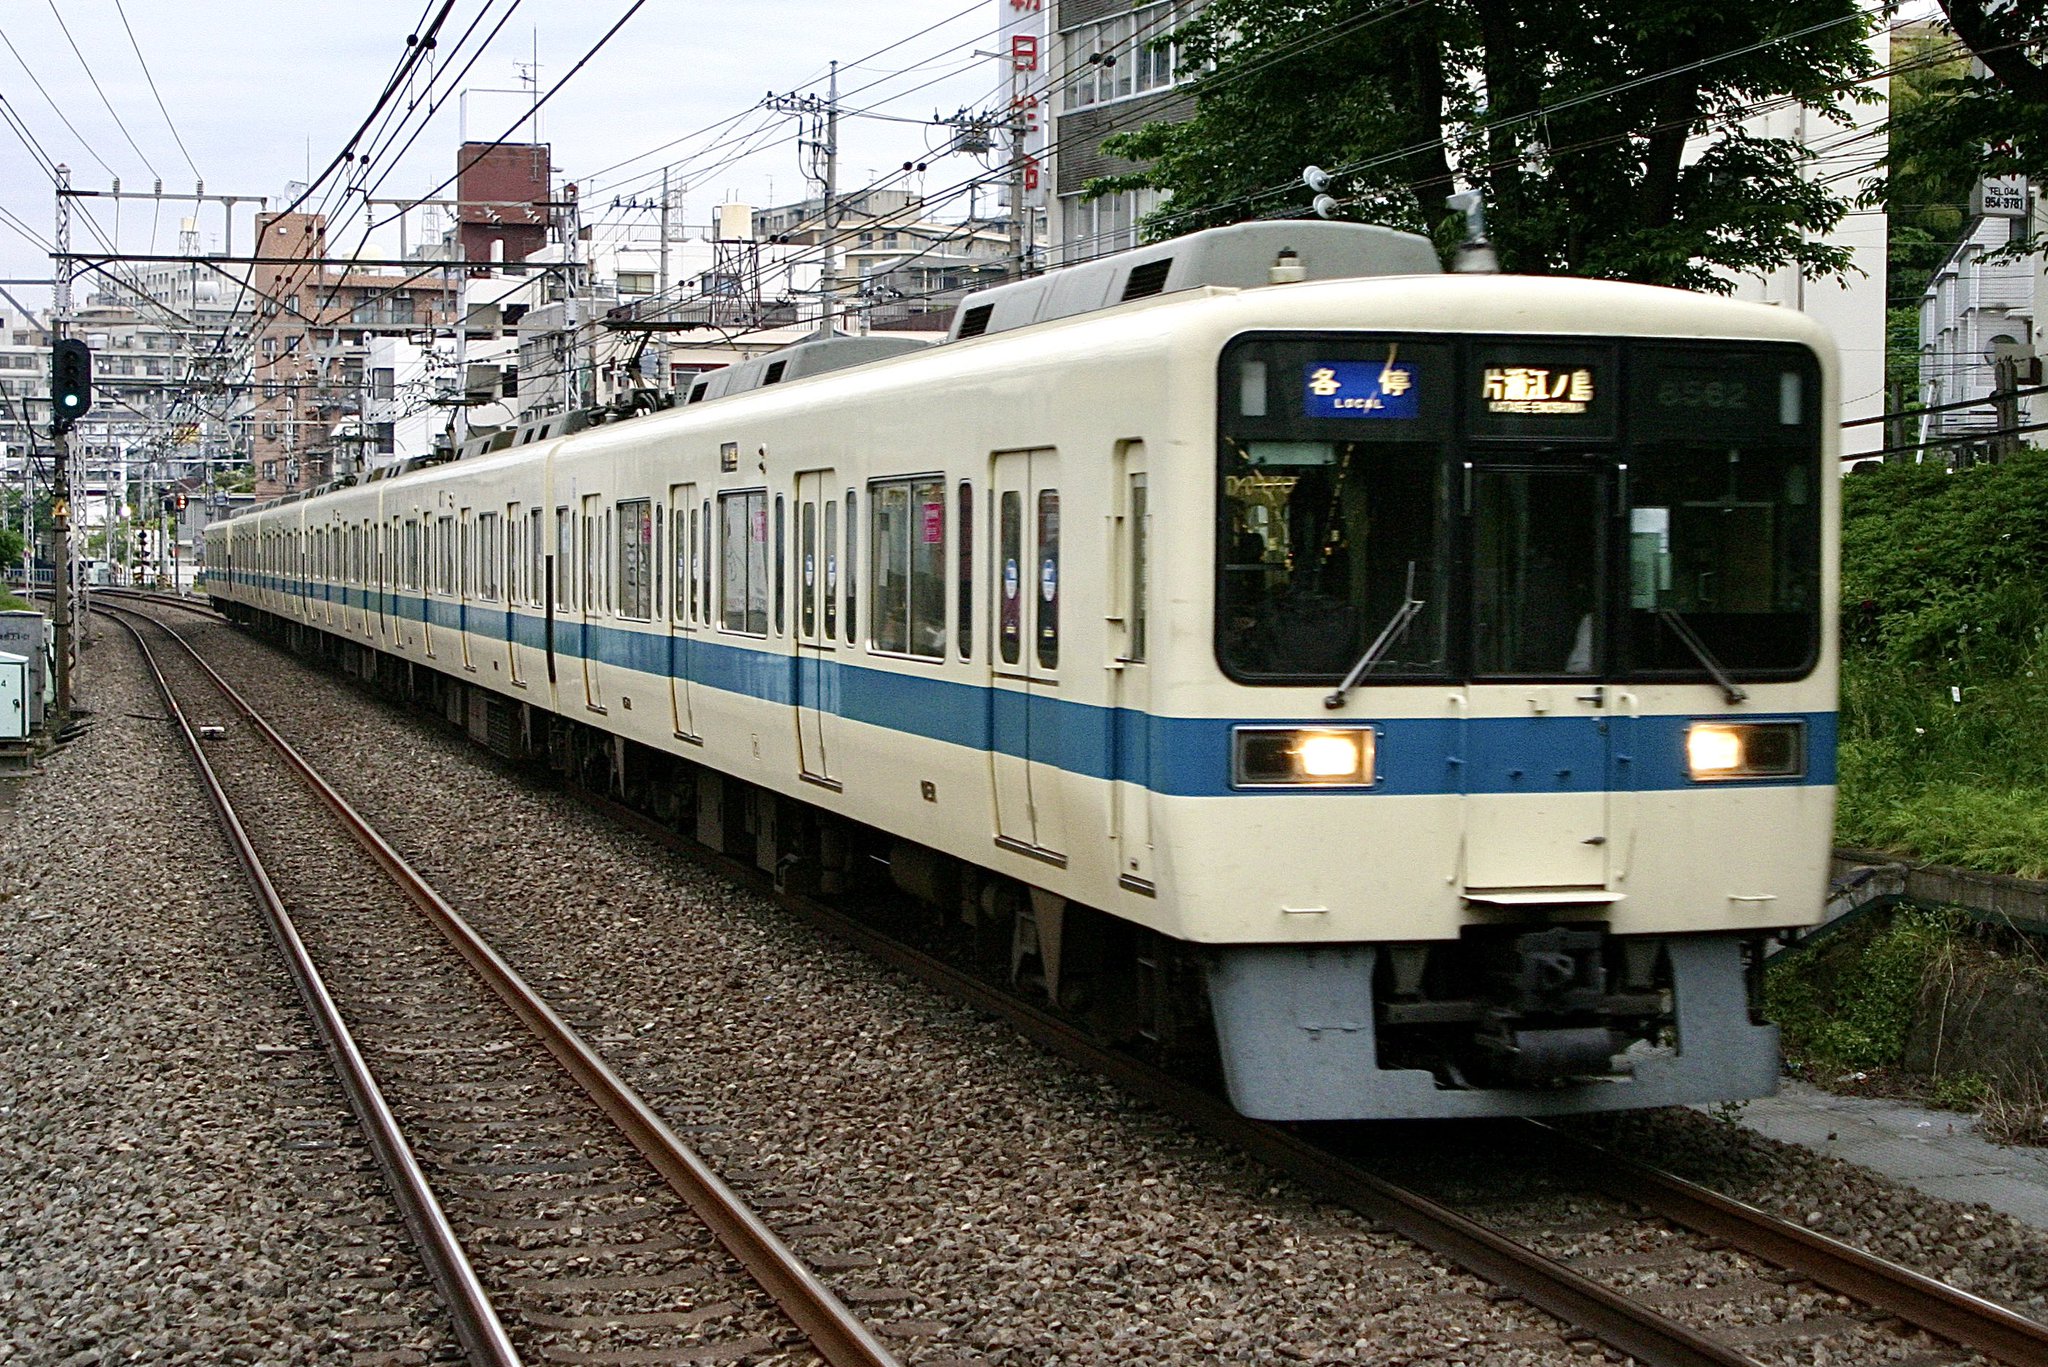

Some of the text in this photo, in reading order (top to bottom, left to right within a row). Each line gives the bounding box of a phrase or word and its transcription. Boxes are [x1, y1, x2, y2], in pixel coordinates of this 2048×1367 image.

[1989, 186, 2019, 196] TEL 044
[1984, 196, 2023, 210] 954-3781
[1308, 367, 1412, 396] 各停
[1333, 397, 1385, 410] LOCAL
